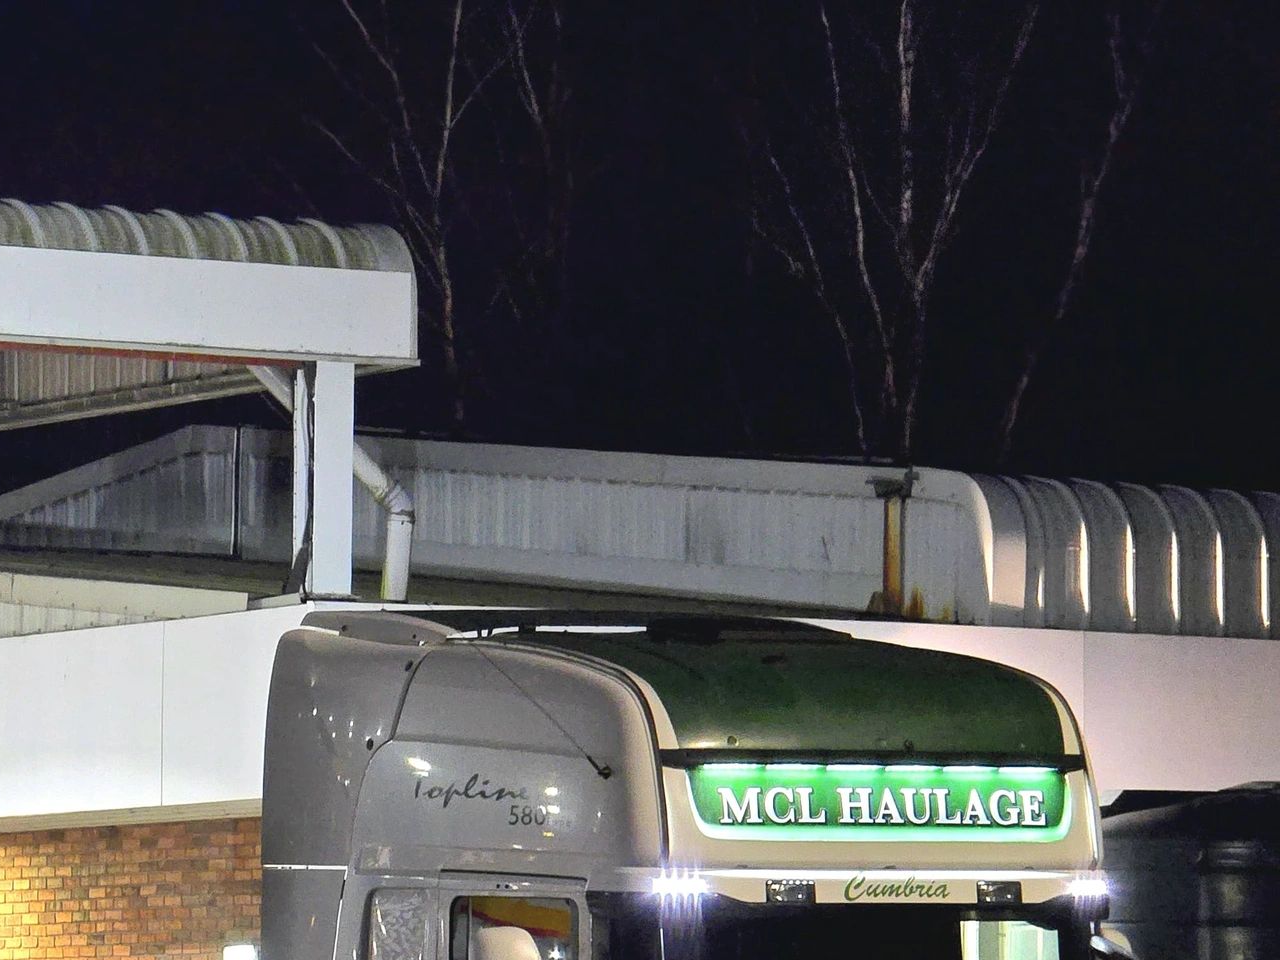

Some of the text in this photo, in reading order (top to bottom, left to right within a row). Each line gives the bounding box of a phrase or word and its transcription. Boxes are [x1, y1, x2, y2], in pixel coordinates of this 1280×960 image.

[508, 804, 546, 826] 580
[718, 786, 1047, 827] MCL HAULAGE
[843, 871, 950, 901] Cumbria
